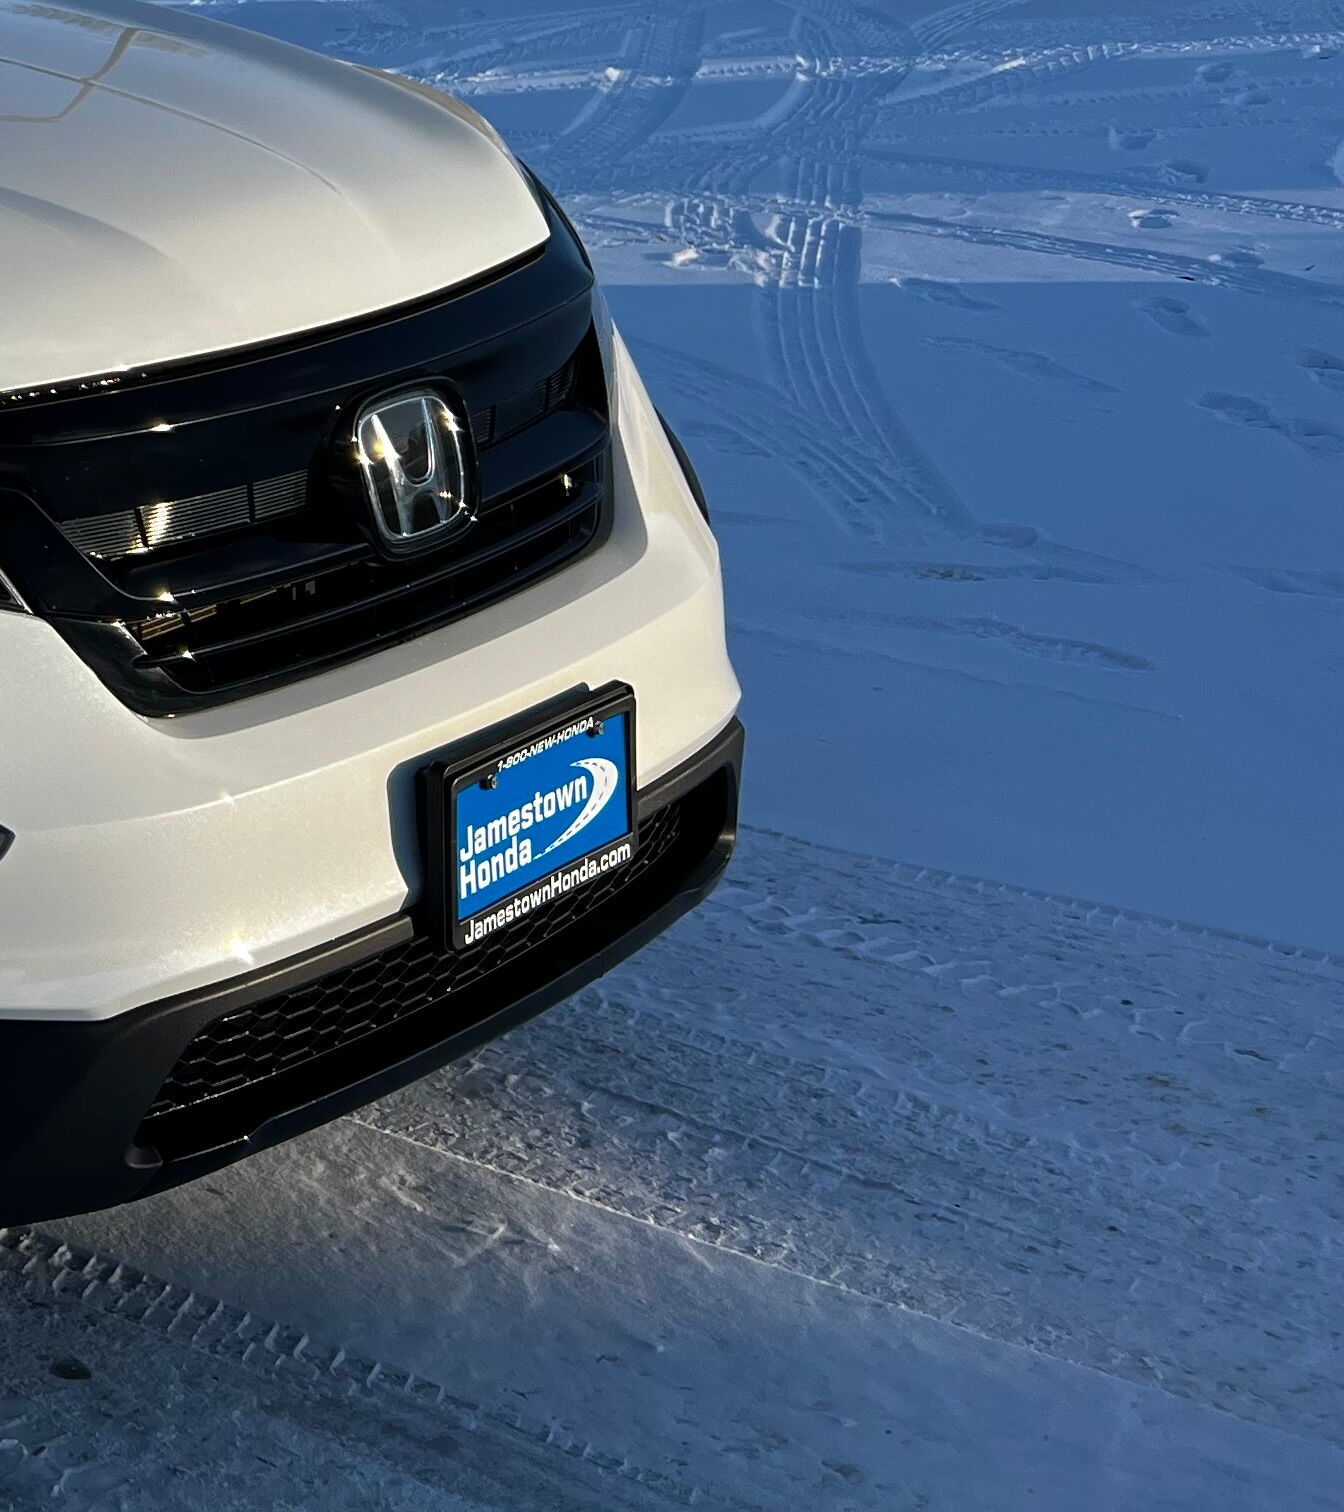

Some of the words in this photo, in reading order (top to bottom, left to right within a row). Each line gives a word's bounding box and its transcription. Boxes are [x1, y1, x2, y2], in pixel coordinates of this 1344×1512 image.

[497, 716, 594, 772] 1-800-NEW-HONDA
[460, 775, 588, 862] Jamestown
[459, 834, 532, 899] Honda
[464, 842, 631, 945] JamestownHonda.com
